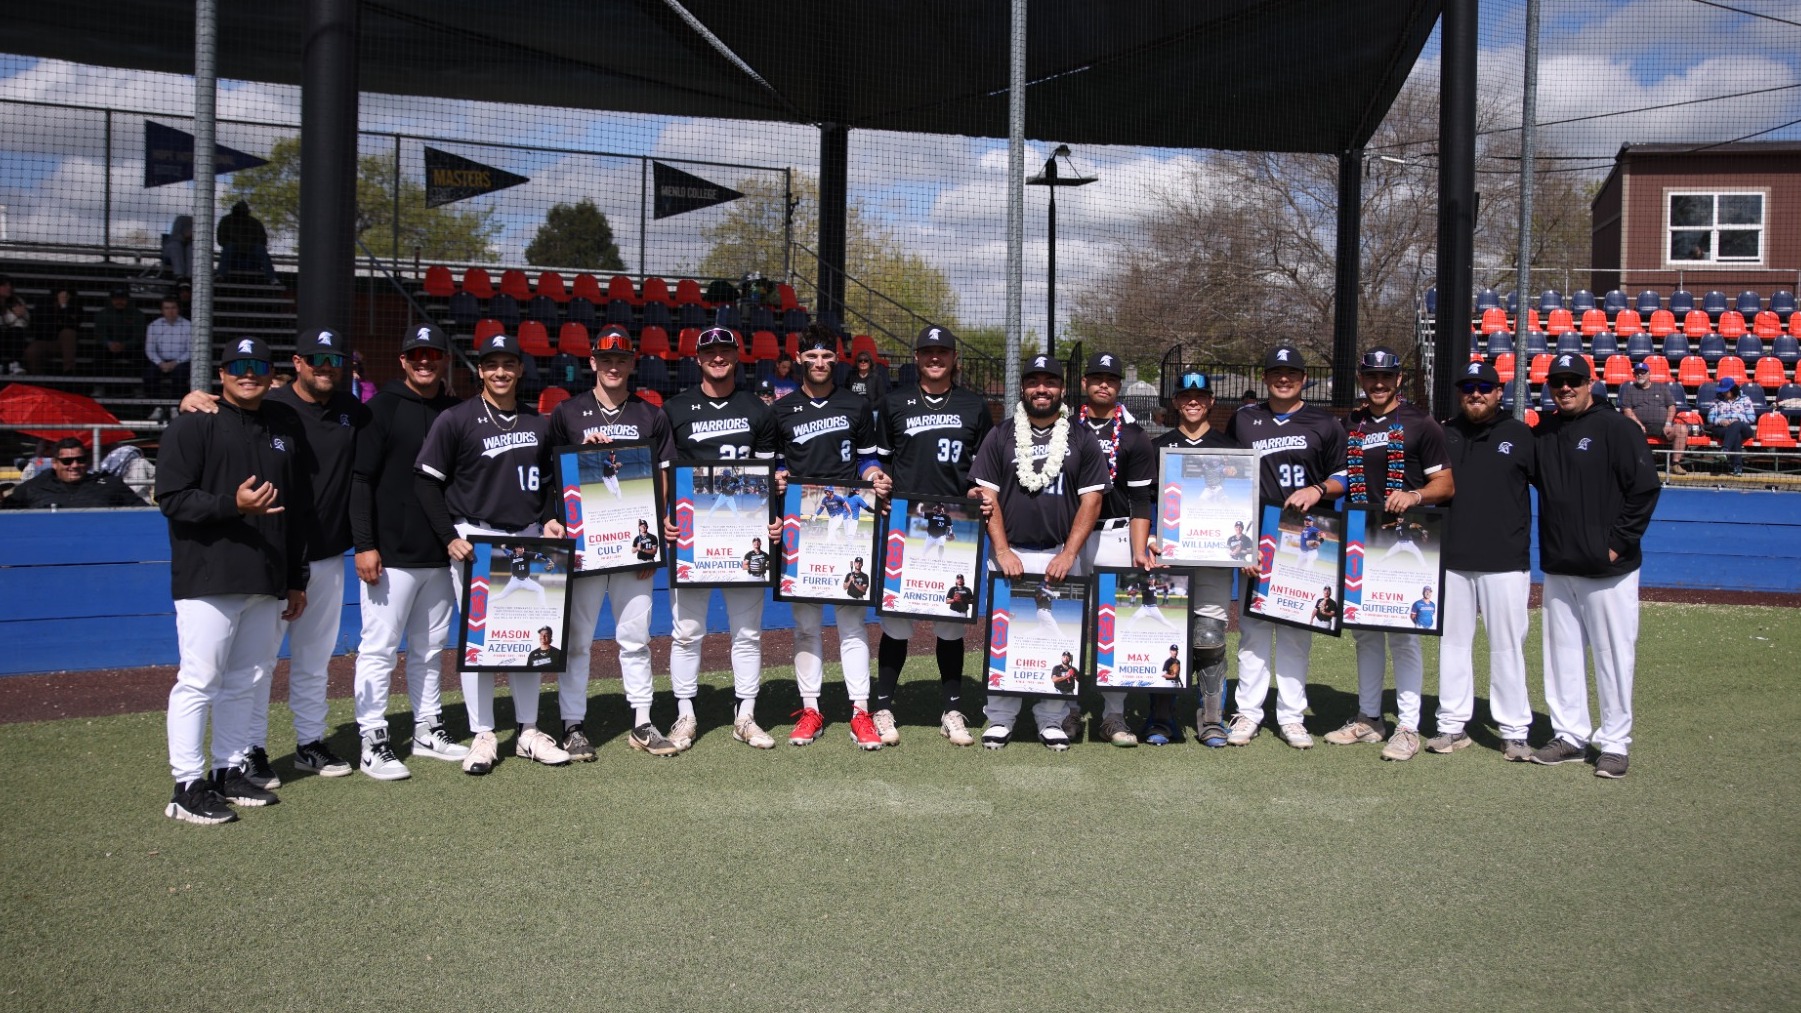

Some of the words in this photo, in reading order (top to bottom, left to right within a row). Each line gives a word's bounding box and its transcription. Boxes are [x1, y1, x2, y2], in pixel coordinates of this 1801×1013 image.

[432, 169, 492, 188] MASTERS
[661, 185, 686, 197] MENLO
[687, 187, 718, 199] COLLEGE
[692, 417, 749, 433] WARRIORS
[793, 415, 848, 437] WARRIORS
[906, 414, 961, 428] WARRIORS
[483, 431, 536, 450] WARRIORS
[1252, 435, 1306, 450] WARRIORS
[841, 440, 851, 462] 2
[937, 438, 963, 463] 33
[517, 465, 540, 491] 16
[1279, 463, 1305, 487] 32
[568, 502, 578, 521] 5
[588, 531, 631, 544] CONNOR
[1186, 529, 1221, 538] JAMES
[597, 545, 623, 556] CULP
[706, 548, 733, 556] NATE
[809, 564, 836, 573] TREY
[803, 576, 840, 586] FURREY
[906, 579, 945, 590] TREVOR
[903, 591, 946, 602] ARNSTON
[1270, 584, 1316, 601] ANTHONY
[1371, 591, 1404, 602] KEVIN
[1277, 597, 1305, 611] PEREZ
[1362, 603, 1410, 614] GUTIERREZ
[491, 630, 530, 639] MASON
[488, 643, 532, 653] AZEVEDO
[1016, 658, 1047, 668] CHRIS
[1127, 653, 1150, 662] MAX
[1014, 671, 1045, 680] LOPEZ
[1119, 665, 1157, 674] MORENO
